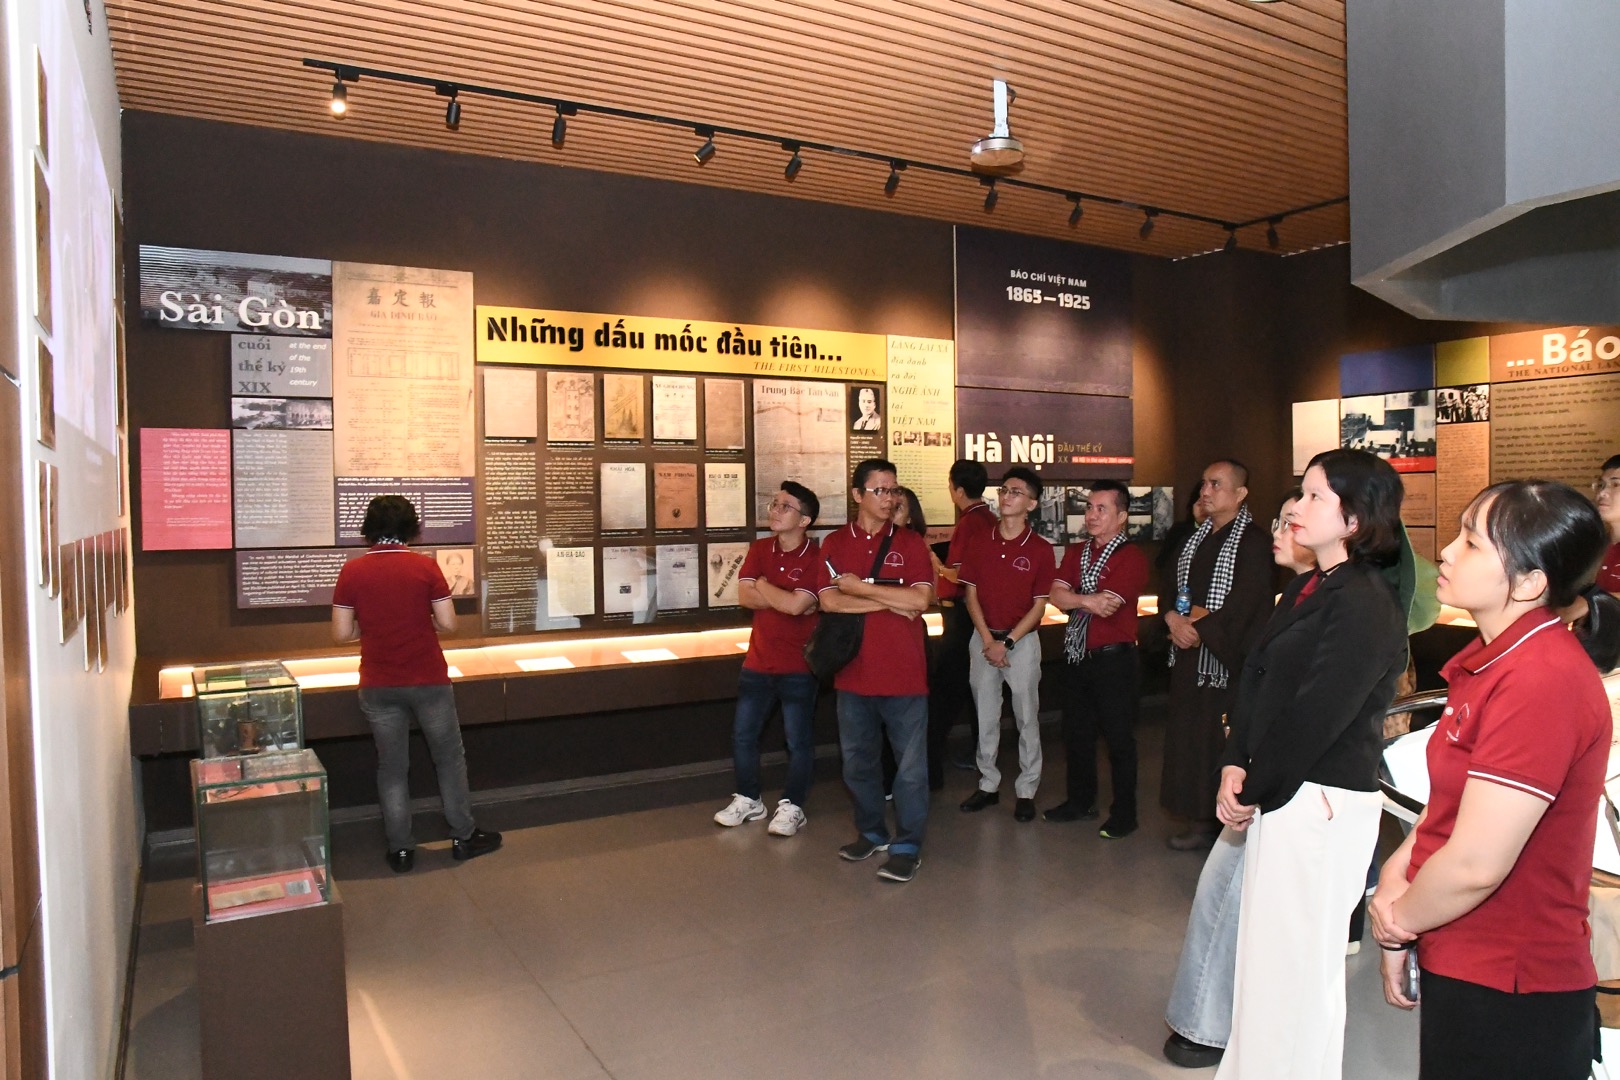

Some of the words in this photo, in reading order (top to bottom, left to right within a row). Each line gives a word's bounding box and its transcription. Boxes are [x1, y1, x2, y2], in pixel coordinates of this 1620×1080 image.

[1010, 268, 1028, 279] BÁO
[1030, 272, 1046, 282] CHÍ
[1047, 274, 1067, 286] VIỆT
[1068, 278, 1087, 287] NAM
[160, 290, 225, 324] Sài
[238, 296, 322, 330] Gòn
[238, 336, 271, 350] cuối
[488, 316, 584, 352] Những
[594, 319, 644, 349] dấu
[655, 324, 707, 353] mốc
[717, 327, 762, 356] đầu
[770, 335, 842, 361] tiên...
[298, 342, 311, 350] the
[238, 358, 263, 372] thế
[754, 362, 775, 370] THE
[779, 364, 810, 373] FIRST
[1508, 370, 1530, 378] THE
[1534, 364, 1592, 375] NATIONAL
[238, 381, 272, 393] XIX
[288, 379, 318, 387] century
[965, 432, 1002, 462] Hà
[1010, 434, 1054, 470] Nội
